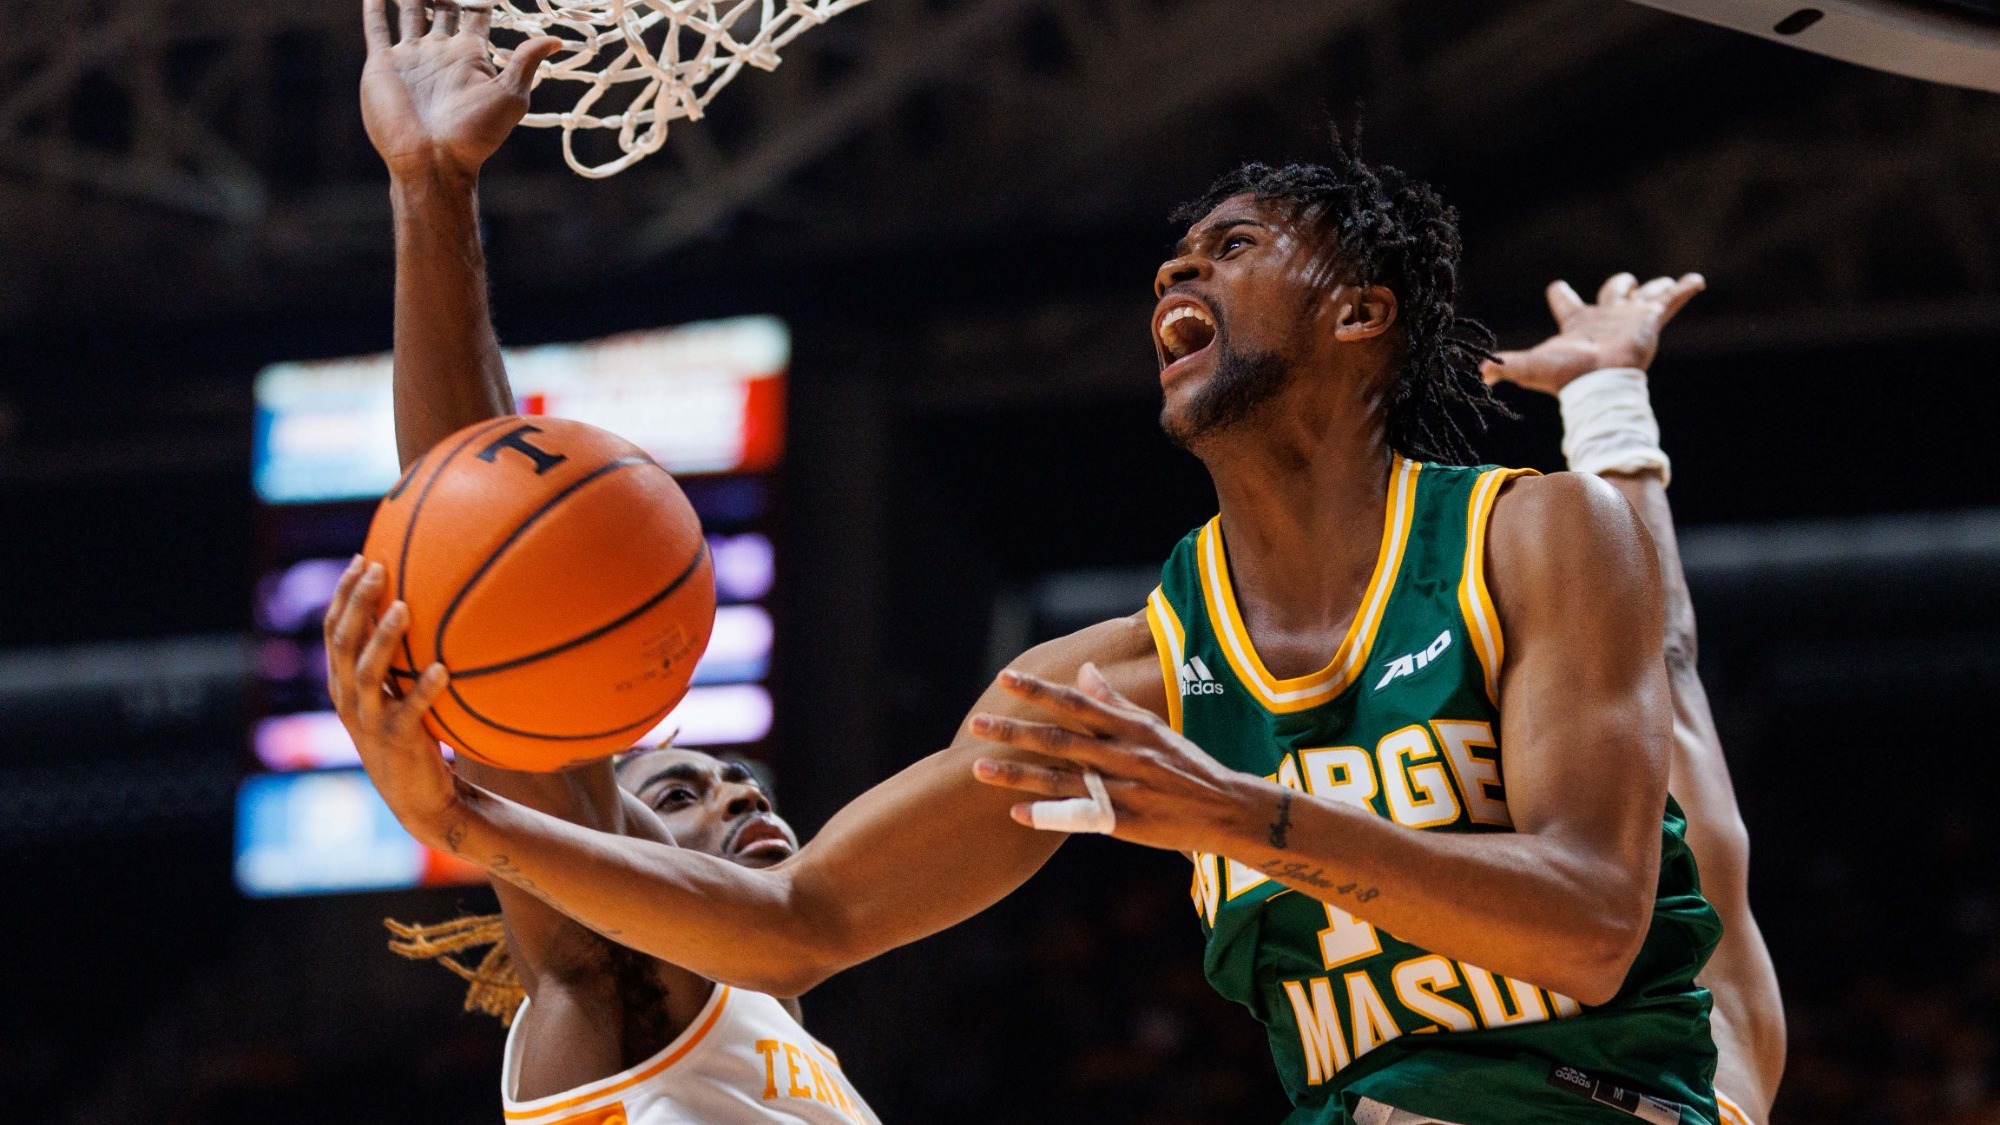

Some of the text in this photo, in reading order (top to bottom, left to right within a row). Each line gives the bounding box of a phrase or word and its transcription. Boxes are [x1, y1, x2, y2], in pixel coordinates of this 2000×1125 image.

[476, 424, 568, 477] T
[1374, 629, 1452, 691] A10
[1182, 680, 1224, 696] didas
[1282, 954, 1582, 1086] MASO
[1555, 1069, 1591, 1089] adidas
[1613, 1086, 1624, 1101] M
